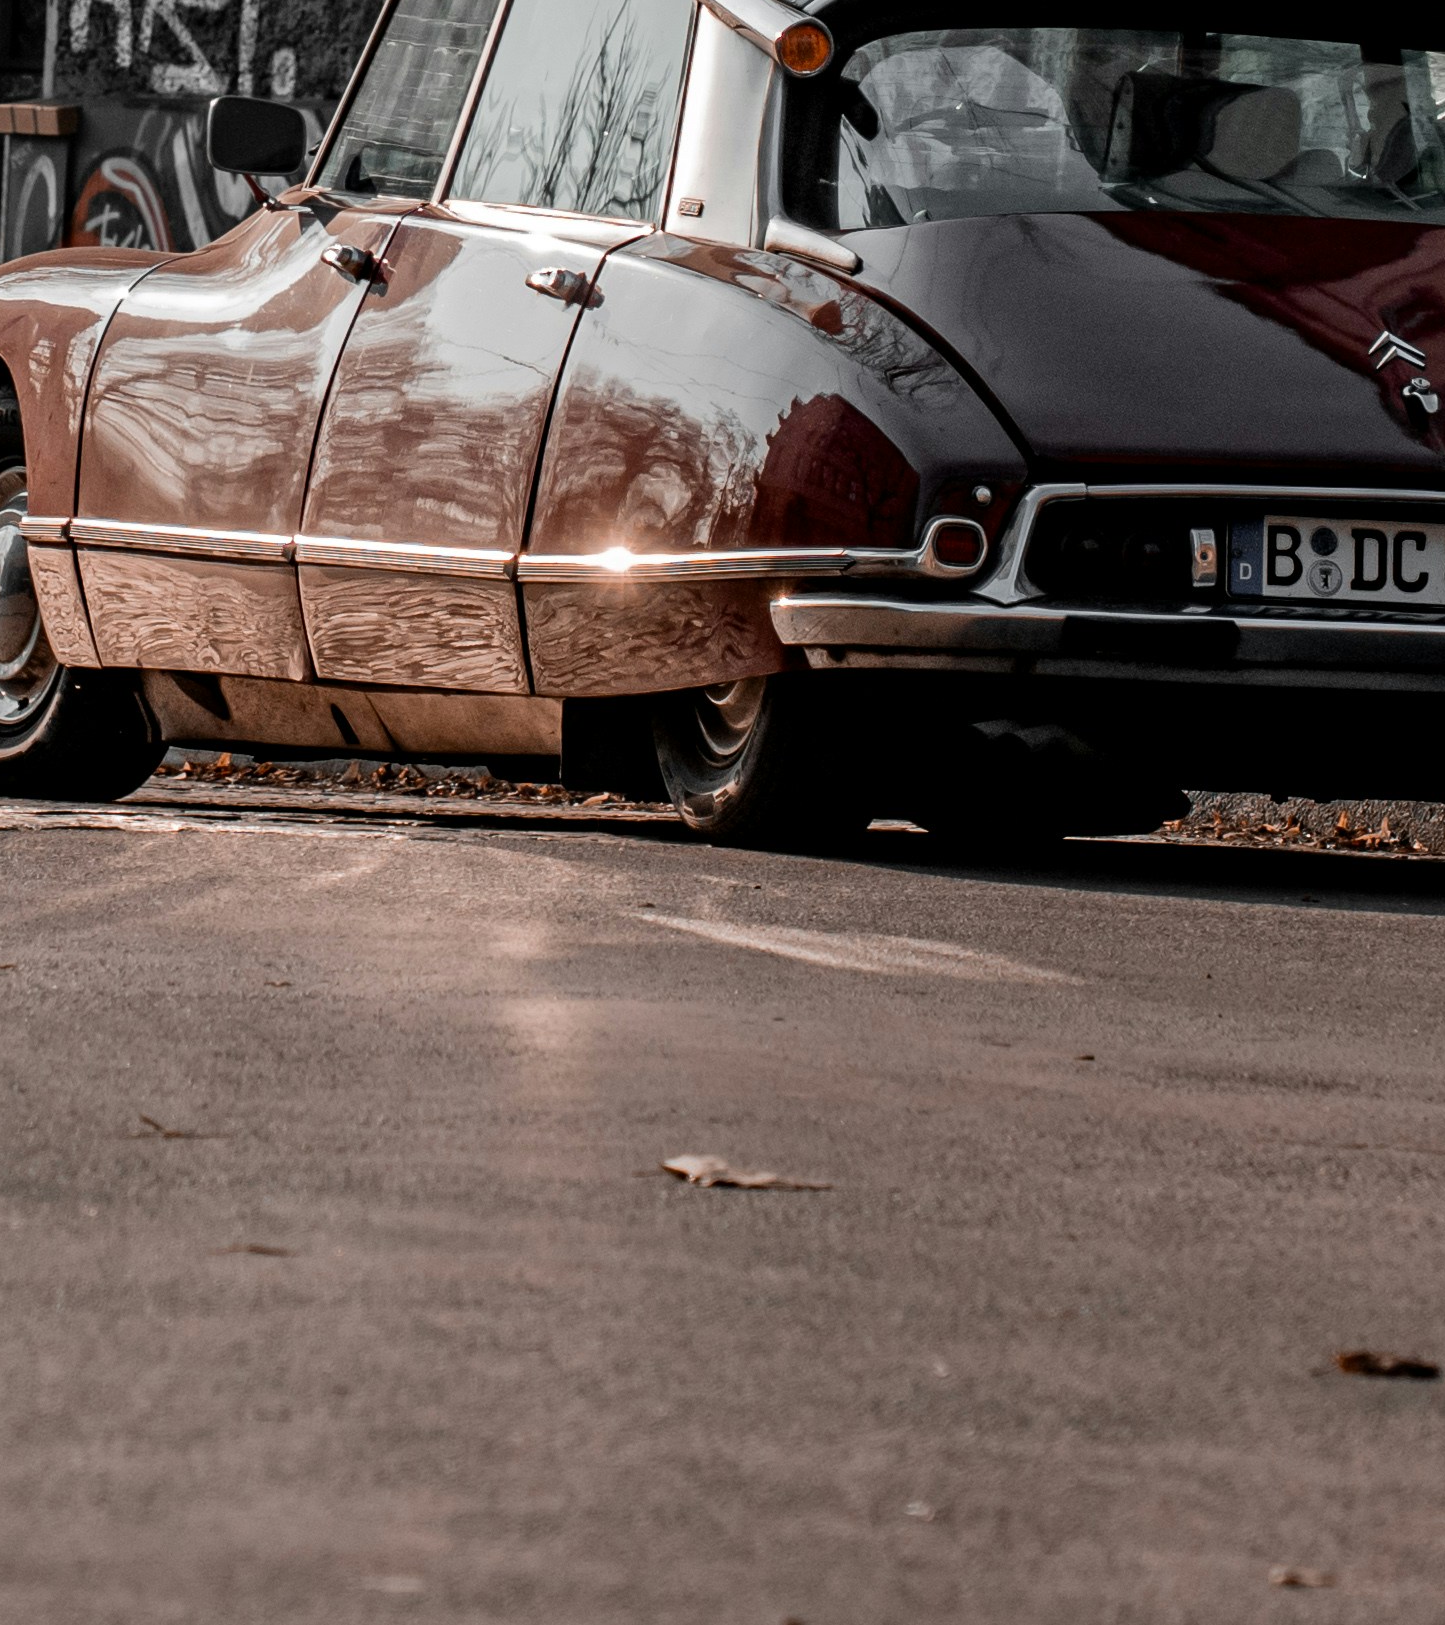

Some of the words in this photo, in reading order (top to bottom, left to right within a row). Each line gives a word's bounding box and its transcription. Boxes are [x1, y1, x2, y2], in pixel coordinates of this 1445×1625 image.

[1239, 562, 1253, 581] D
[1266, 524, 1304, 587] B
[1350, 528, 1430, 593] DC
